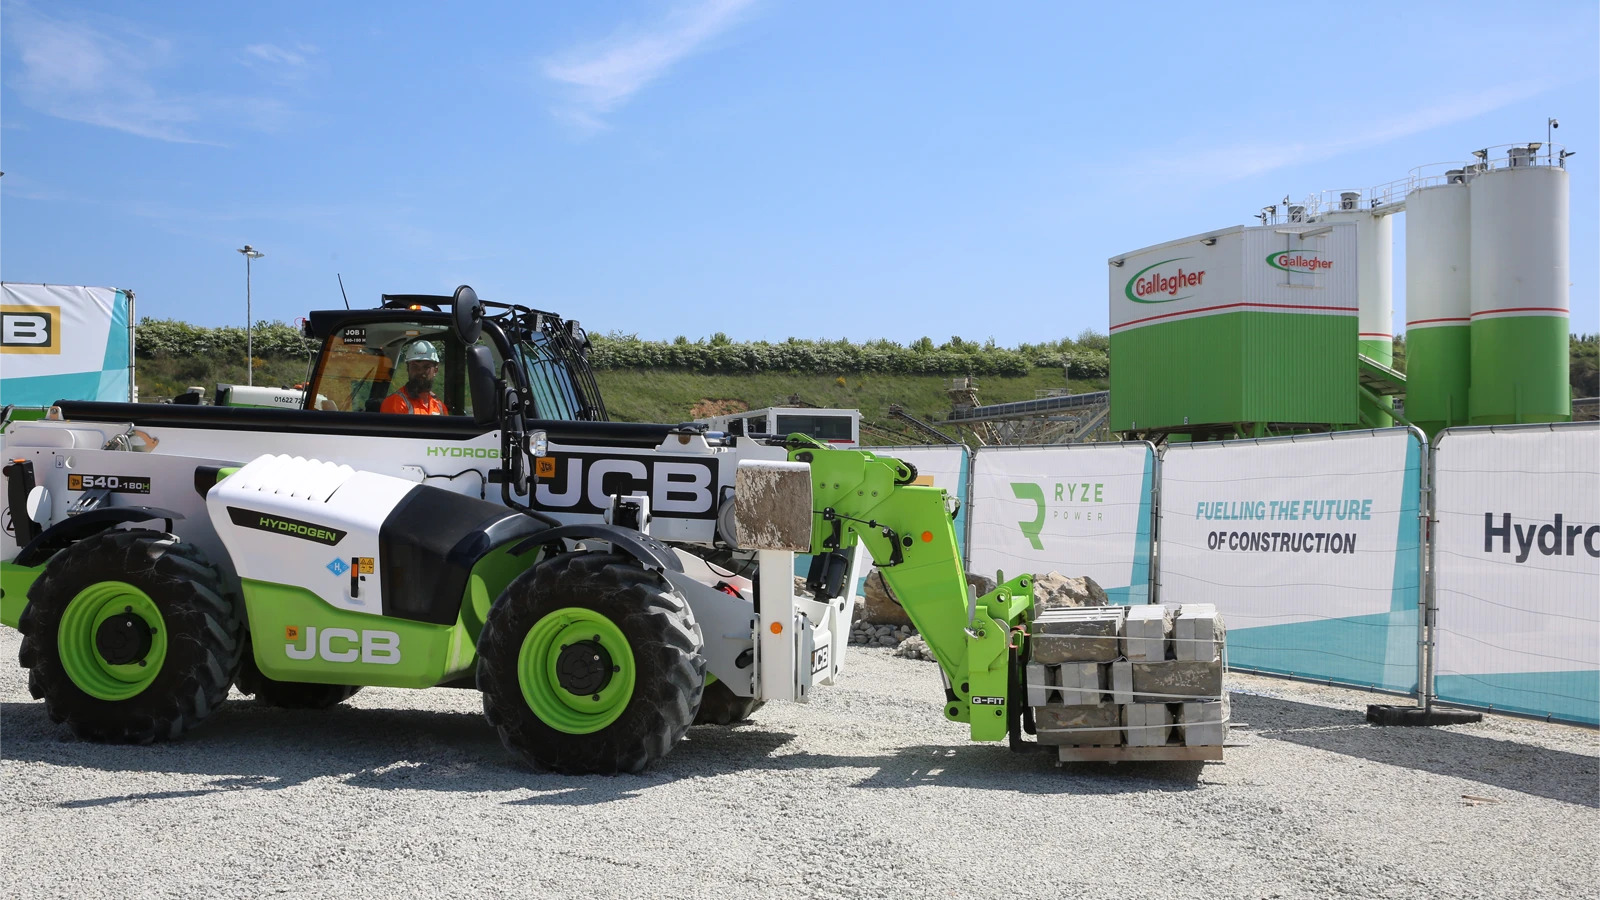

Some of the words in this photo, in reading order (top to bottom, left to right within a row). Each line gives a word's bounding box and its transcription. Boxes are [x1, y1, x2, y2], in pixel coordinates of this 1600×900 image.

[1278, 254, 1333, 271] Gallagher
[1135, 268, 1205, 297] Gallagher
[427, 446, 502, 458] HYDROG
[535, 458, 712, 513] JCB
[1055, 483, 1104, 502] RYZE
[1053, 510, 1103, 521] POWER
[1196, 501, 1265, 520] FUELLING
[1268, 501, 1302, 520] THE
[1302, 499, 1372, 520] FUTURE
[259, 517, 336, 541] HYDROGEN
[1208, 532, 1226, 550] OF
[1228, 532, 1356, 554] CONSTRUCTION
[285, 627, 401, 665] JCB
[812, 646, 828, 672] JCB
